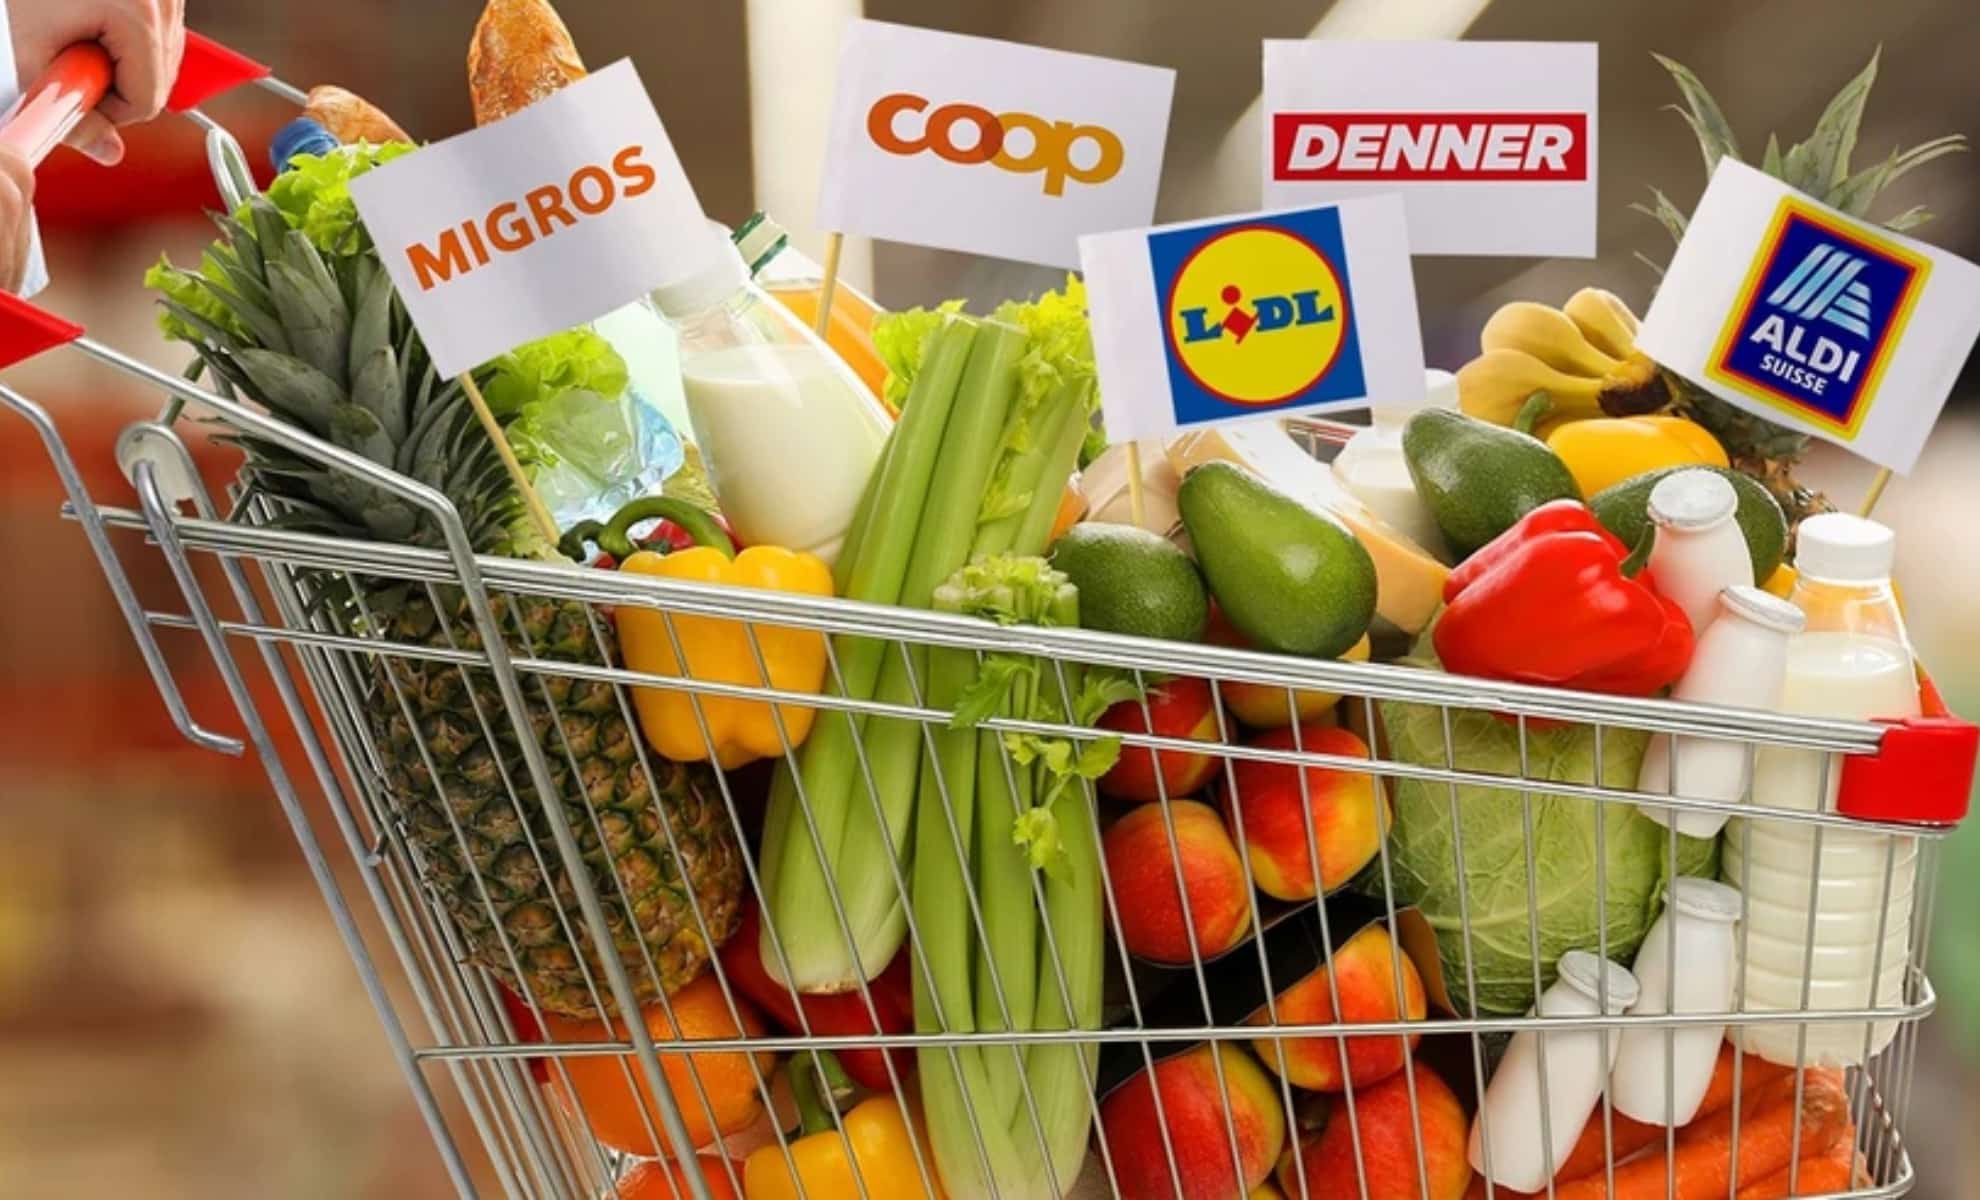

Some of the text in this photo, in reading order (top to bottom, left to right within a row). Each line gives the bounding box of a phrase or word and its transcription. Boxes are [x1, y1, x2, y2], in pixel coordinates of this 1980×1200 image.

[867, 93, 1124, 196] coop
[1287, 124, 1573, 171] DENNER
[405, 146, 656, 290] MIGROS
[1750, 314, 1861, 383] ALDI
[1760, 354, 1829, 395] SUISSE
